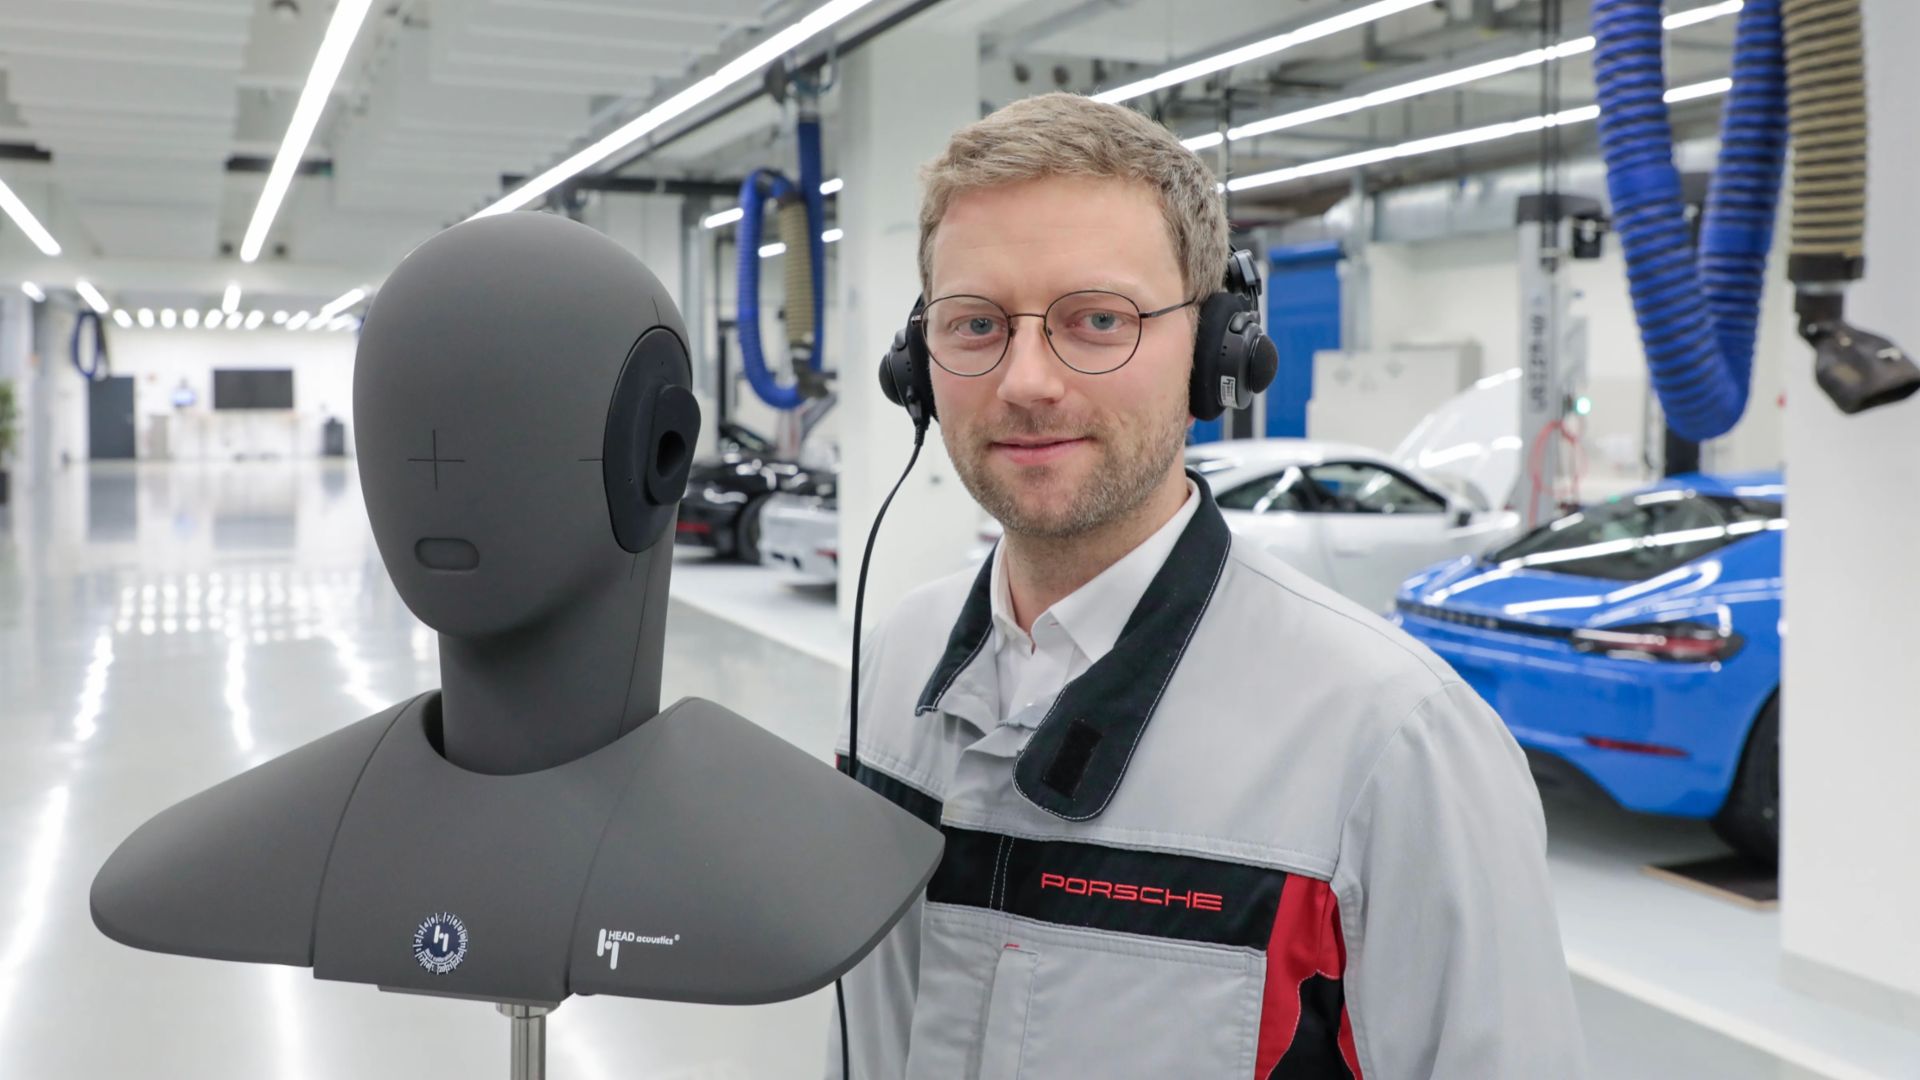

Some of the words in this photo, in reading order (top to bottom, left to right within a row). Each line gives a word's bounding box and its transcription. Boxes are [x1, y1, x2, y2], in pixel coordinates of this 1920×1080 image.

[1041, 872, 1223, 911] PORSCHE
[608, 930, 635, 942] HEAD
[636, 935, 673, 945] acoustics
